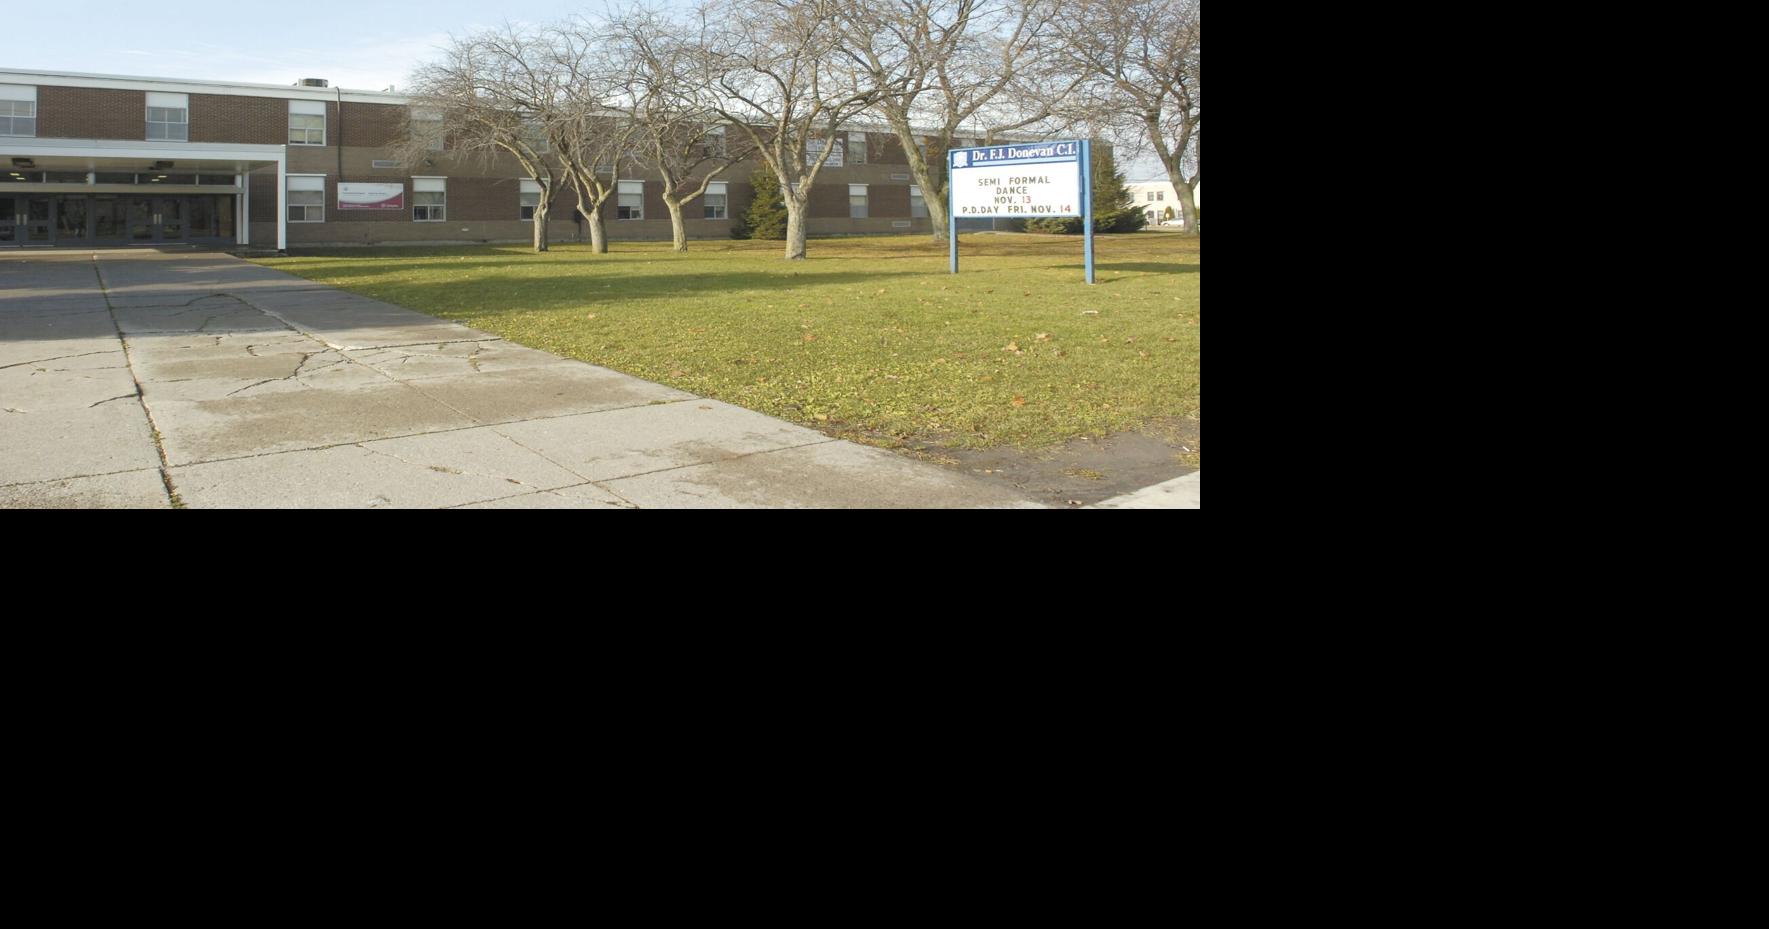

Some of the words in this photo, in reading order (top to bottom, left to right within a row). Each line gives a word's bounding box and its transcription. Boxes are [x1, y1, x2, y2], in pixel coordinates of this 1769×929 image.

[972, 150, 987, 161] Dr.
[990, 148, 1005, 160] F.J.
[1008, 146, 1053, 158] Donevan
[1056, 143, 1076, 155] C.I.
[978, 178, 1000, 186] SEMI
[1009, 176, 1051, 185] FORMAL
[996, 186, 1027, 195] DANCE
[994, 196, 1016, 204] NOV.
[962, 206, 999, 214] P.D.DAY
[1007, 205, 1027, 213] FRI.
[1031, 205, 1056, 213] NOV.
[1060, 204, 1071, 213] 14
